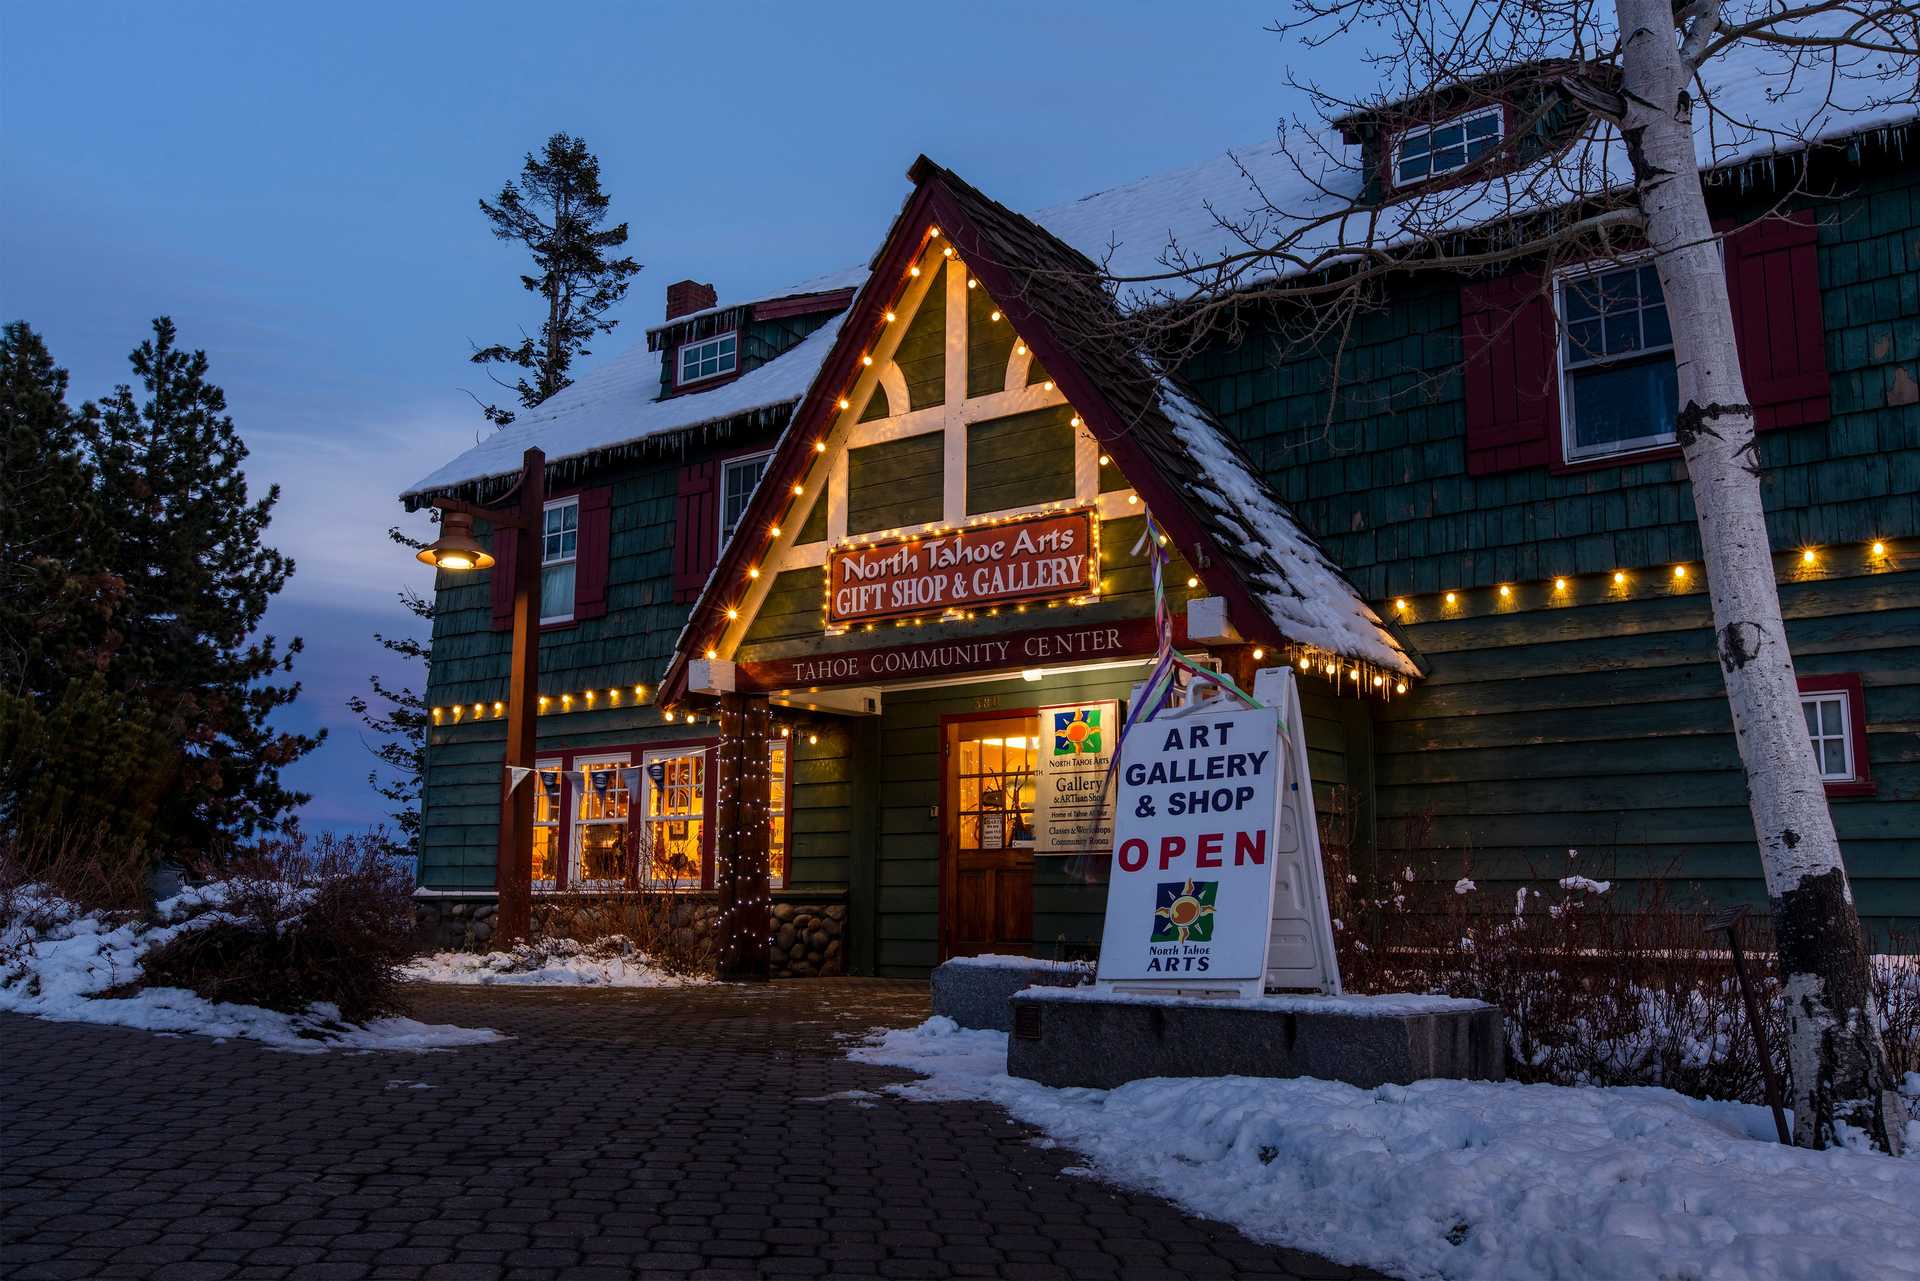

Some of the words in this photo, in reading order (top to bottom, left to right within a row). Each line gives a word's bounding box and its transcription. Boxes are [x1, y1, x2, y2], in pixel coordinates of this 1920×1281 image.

[841, 546, 918, 583] North
[922, 538, 1005, 570] Tahoe
[1011, 527, 1074, 556] Arts
[836, 582, 888, 615] GIFT
[891, 574, 948, 608] SHOP
[952, 572, 968, 599] &
[972, 555, 1085, 596] GALLERY
[792, 657, 859, 681] TAHOE
[870, 640, 1011, 673] COMMUNITY
[1024, 629, 1123, 658] CENTER
[1162, 722, 1234, 751] ART
[1056, 776, 1103, 793] Gallery
[1125, 751, 1269, 786] GALLERY
[1135, 794, 1156, 818] &
[1168, 787, 1254, 816] SHOP
[1118, 830, 1266, 872] OPEN
[1146, 956, 1210, 972] ARTS
